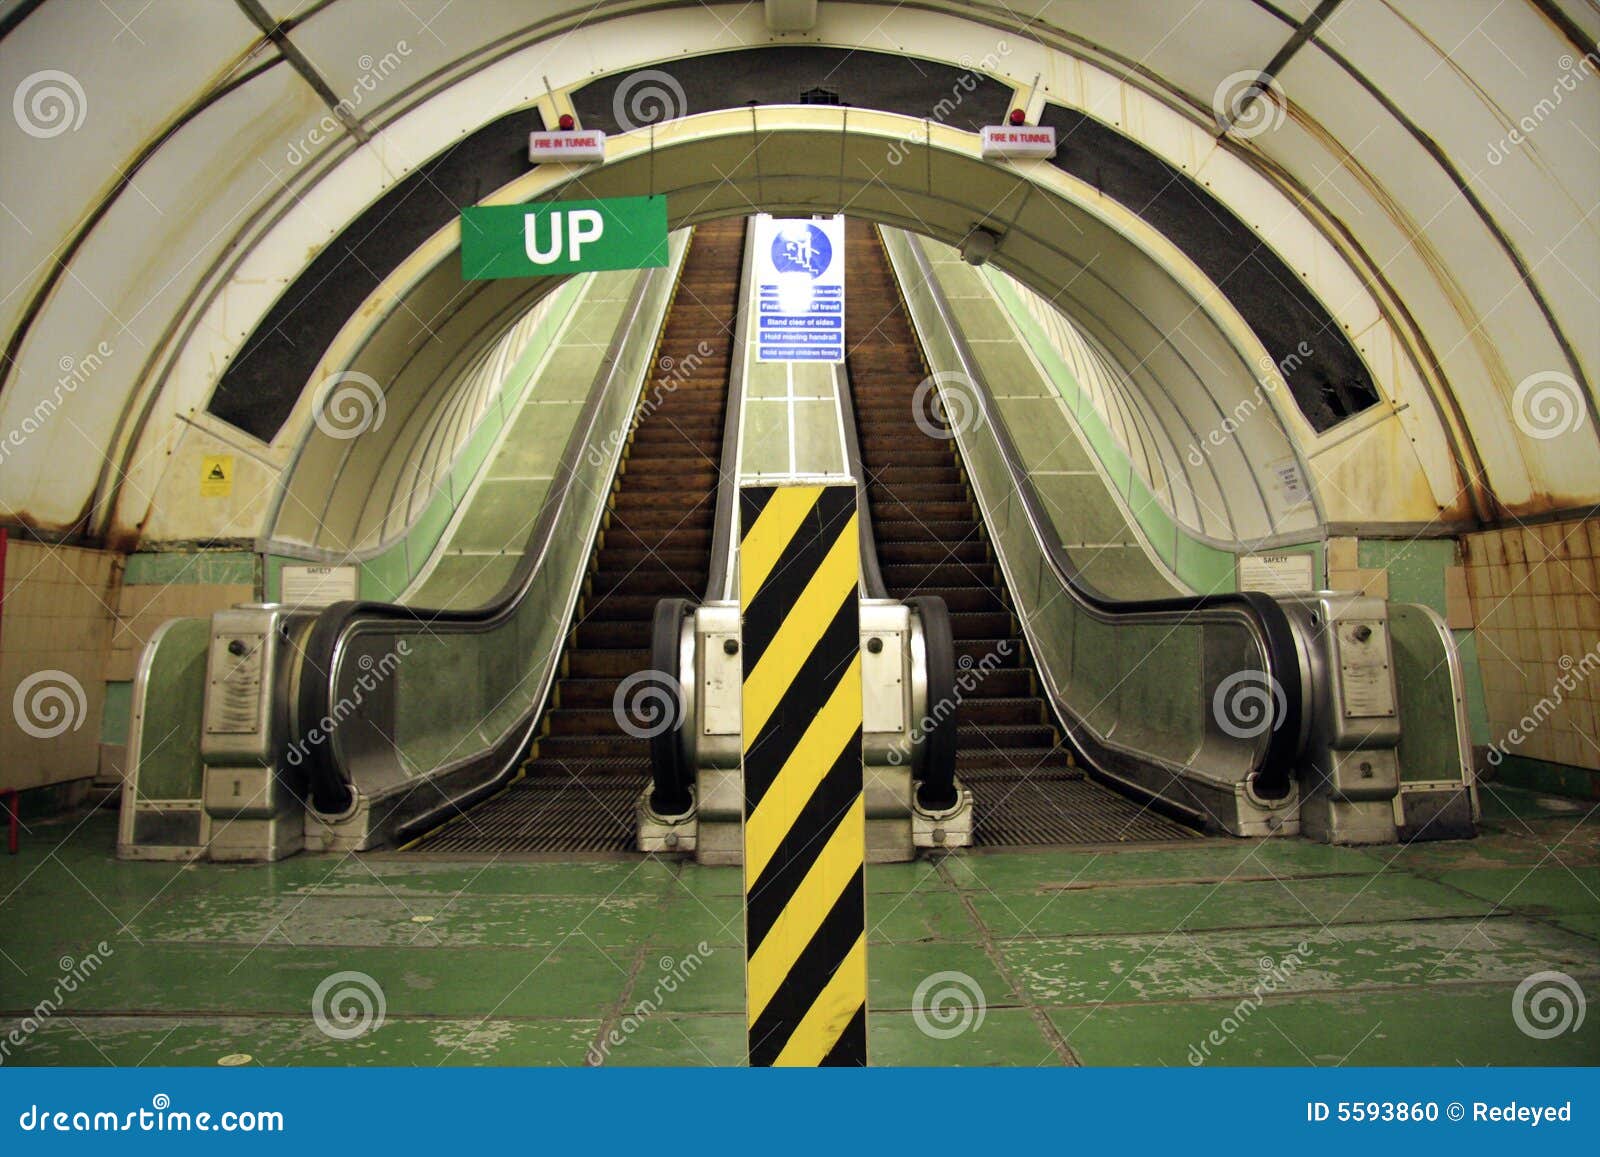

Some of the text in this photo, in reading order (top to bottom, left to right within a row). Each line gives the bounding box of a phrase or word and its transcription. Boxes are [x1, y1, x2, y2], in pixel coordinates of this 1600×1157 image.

[534, 136, 597, 148] FIRE IN TUNNEL
[990, 133, 1051, 143] FIRE IN TUNNEL
[524, 209, 604, 265] UP
[788, 318, 806, 326] clear
[807, 318, 815, 326] of
[815, 318, 835, 326] sides
